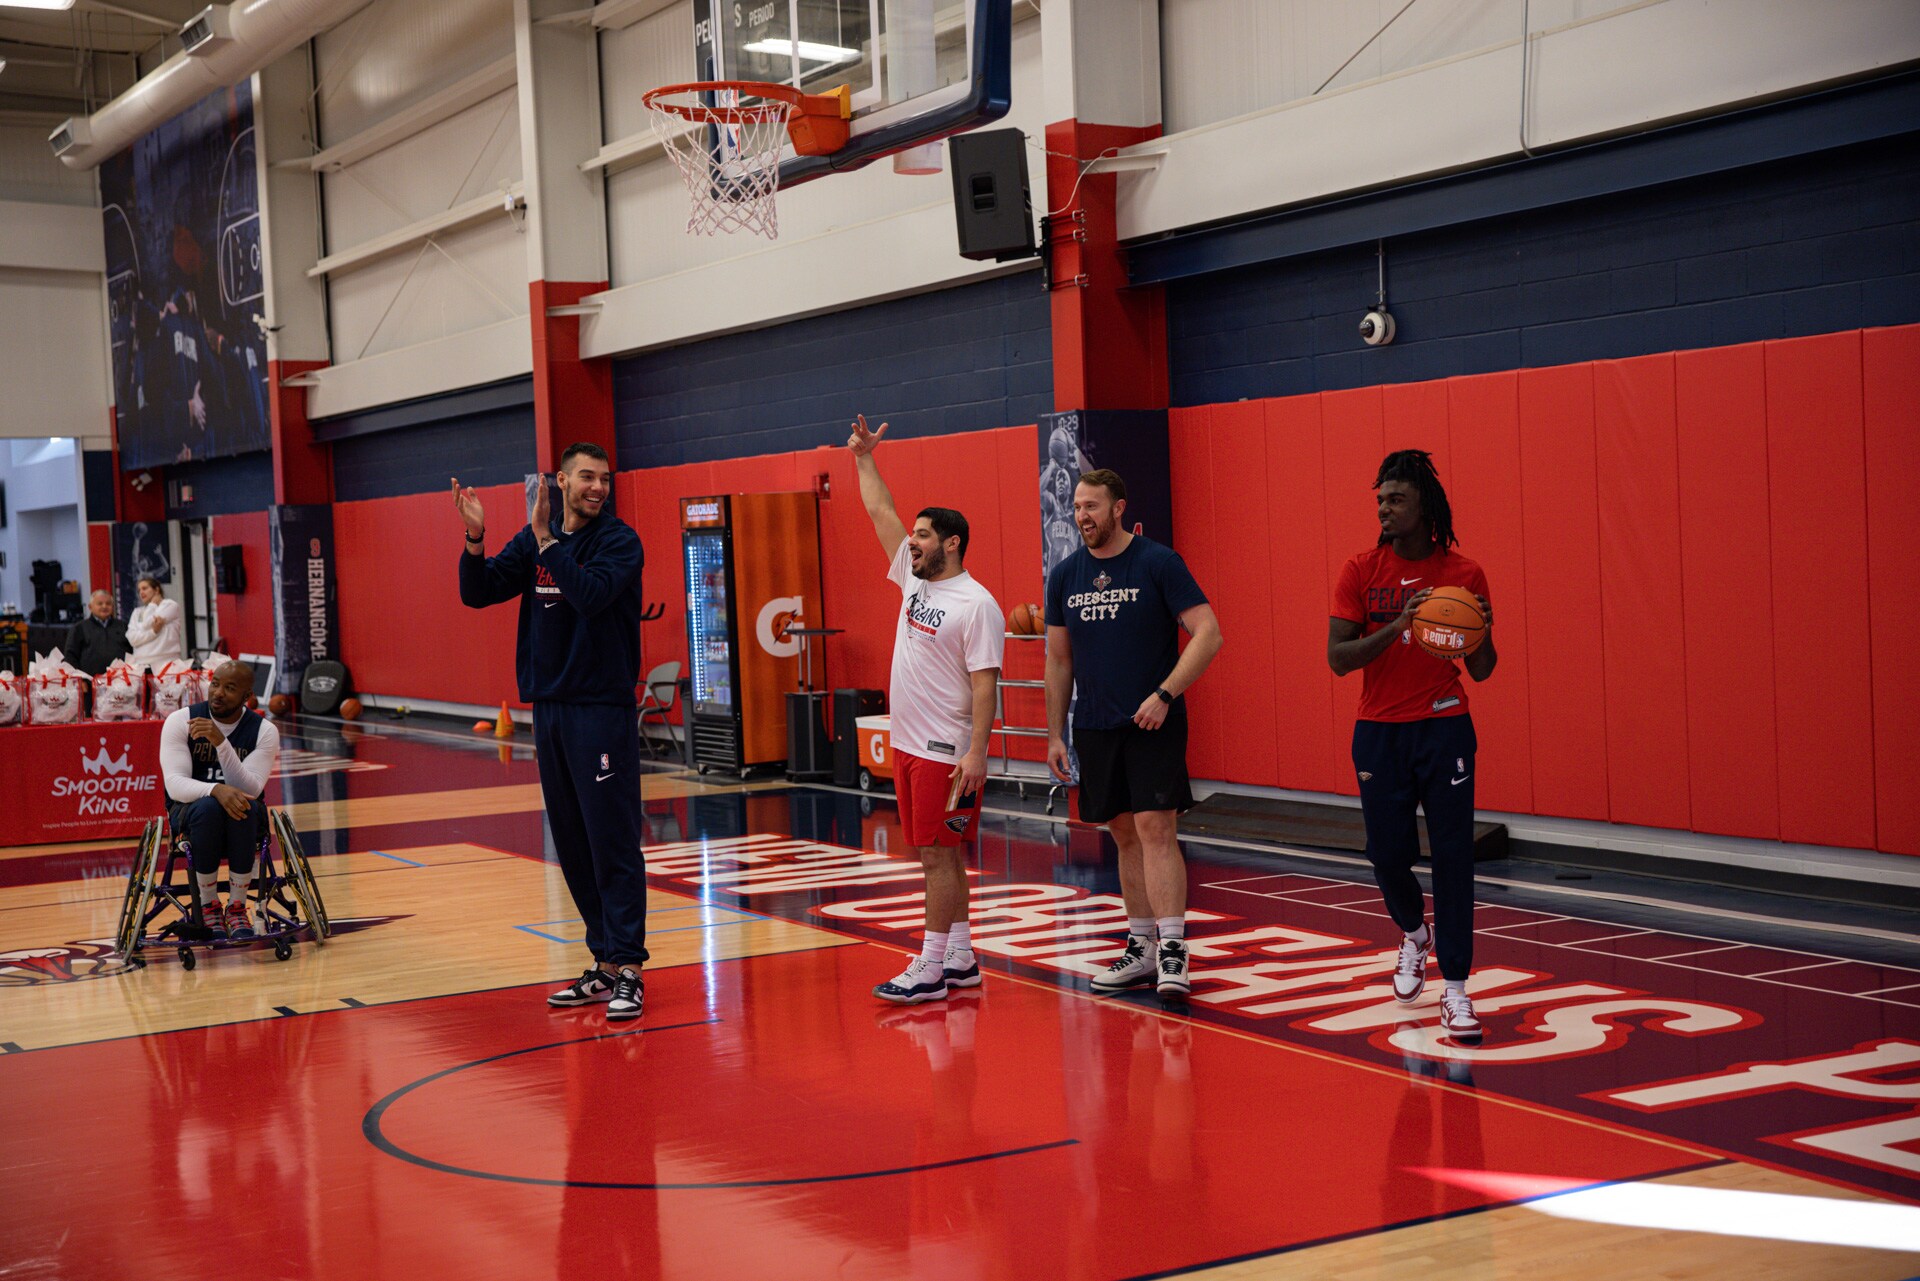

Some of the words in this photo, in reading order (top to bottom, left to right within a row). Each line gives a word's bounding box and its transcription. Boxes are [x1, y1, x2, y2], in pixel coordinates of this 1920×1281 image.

[749, 2, 775, 28] PERIOD
[687, 503, 719, 516] GATORADE
[1067, 588, 1140, 608] CRESCENT
[1080, 603, 1119, 621] CITY
[756, 595, 806, 658] G
[870, 733, 885, 764] G
[51, 775, 158, 797] SMOOTHIE
